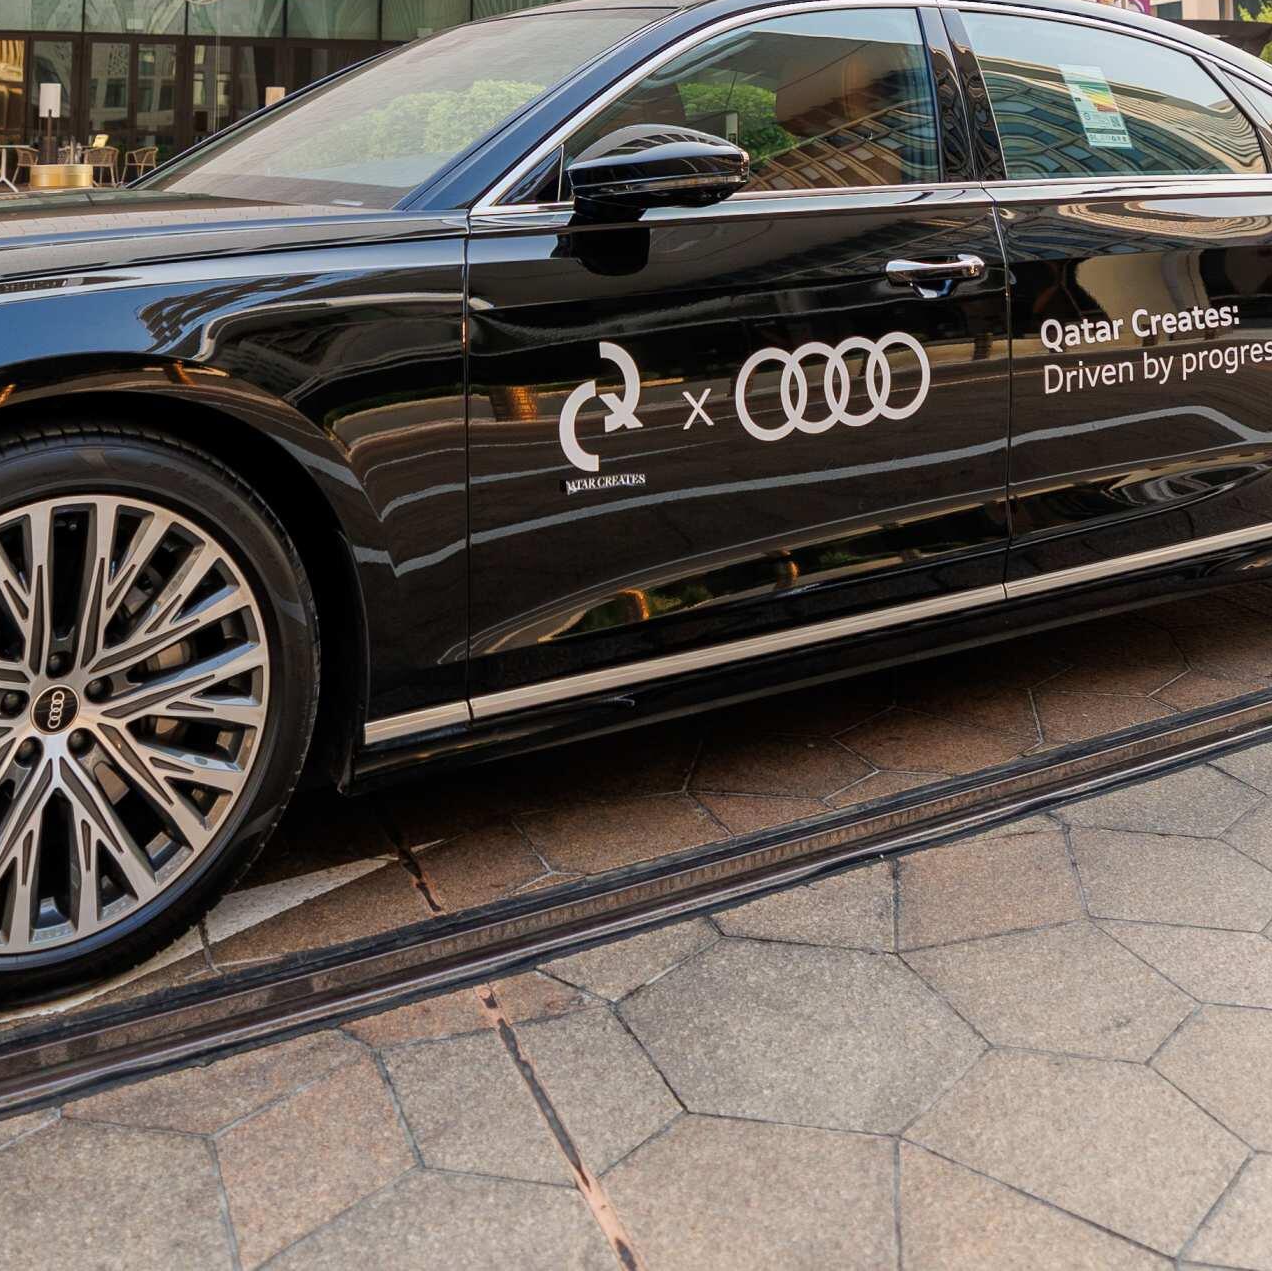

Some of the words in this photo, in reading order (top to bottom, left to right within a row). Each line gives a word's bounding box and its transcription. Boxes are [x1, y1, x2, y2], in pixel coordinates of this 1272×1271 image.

[1040, 318, 1124, 353] Qatar
[1131, 304, 1241, 338] Creates:
[1043, 360, 1134, 395] Driven
[1143, 351, 1174, 385] by
[597, 473, 646, 490] CREATES
